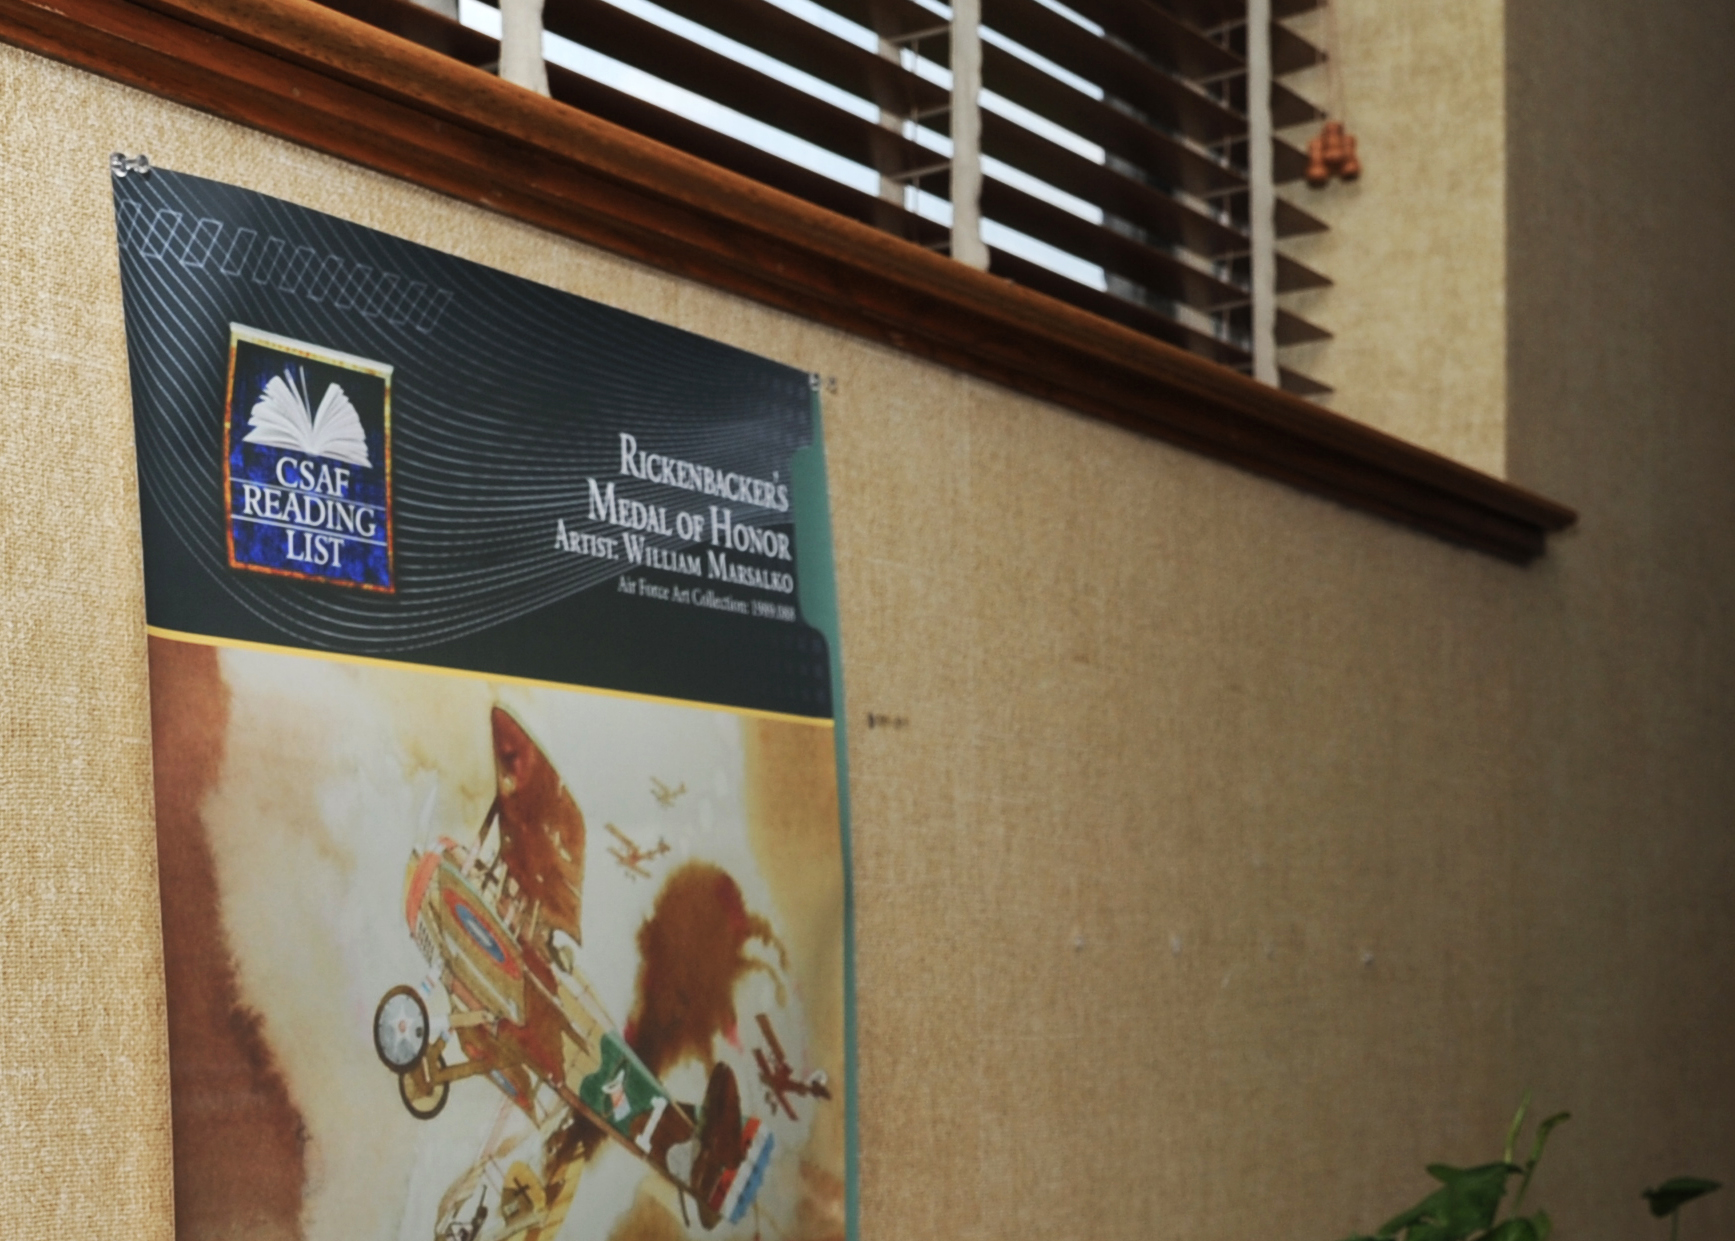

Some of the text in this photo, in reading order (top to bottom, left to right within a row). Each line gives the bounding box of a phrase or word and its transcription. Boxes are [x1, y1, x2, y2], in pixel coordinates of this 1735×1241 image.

[276, 456, 350, 497] CSAF
[619, 432, 789, 512] RICKENBACKER'S
[242, 484, 376, 536] READING
[586, 477, 792, 561] MEDAL OF HONOR
[286, 530, 344, 567] LIST
[622, 532, 702, 576] WILLIAM
[706, 550, 794, 594] MARSALKO
